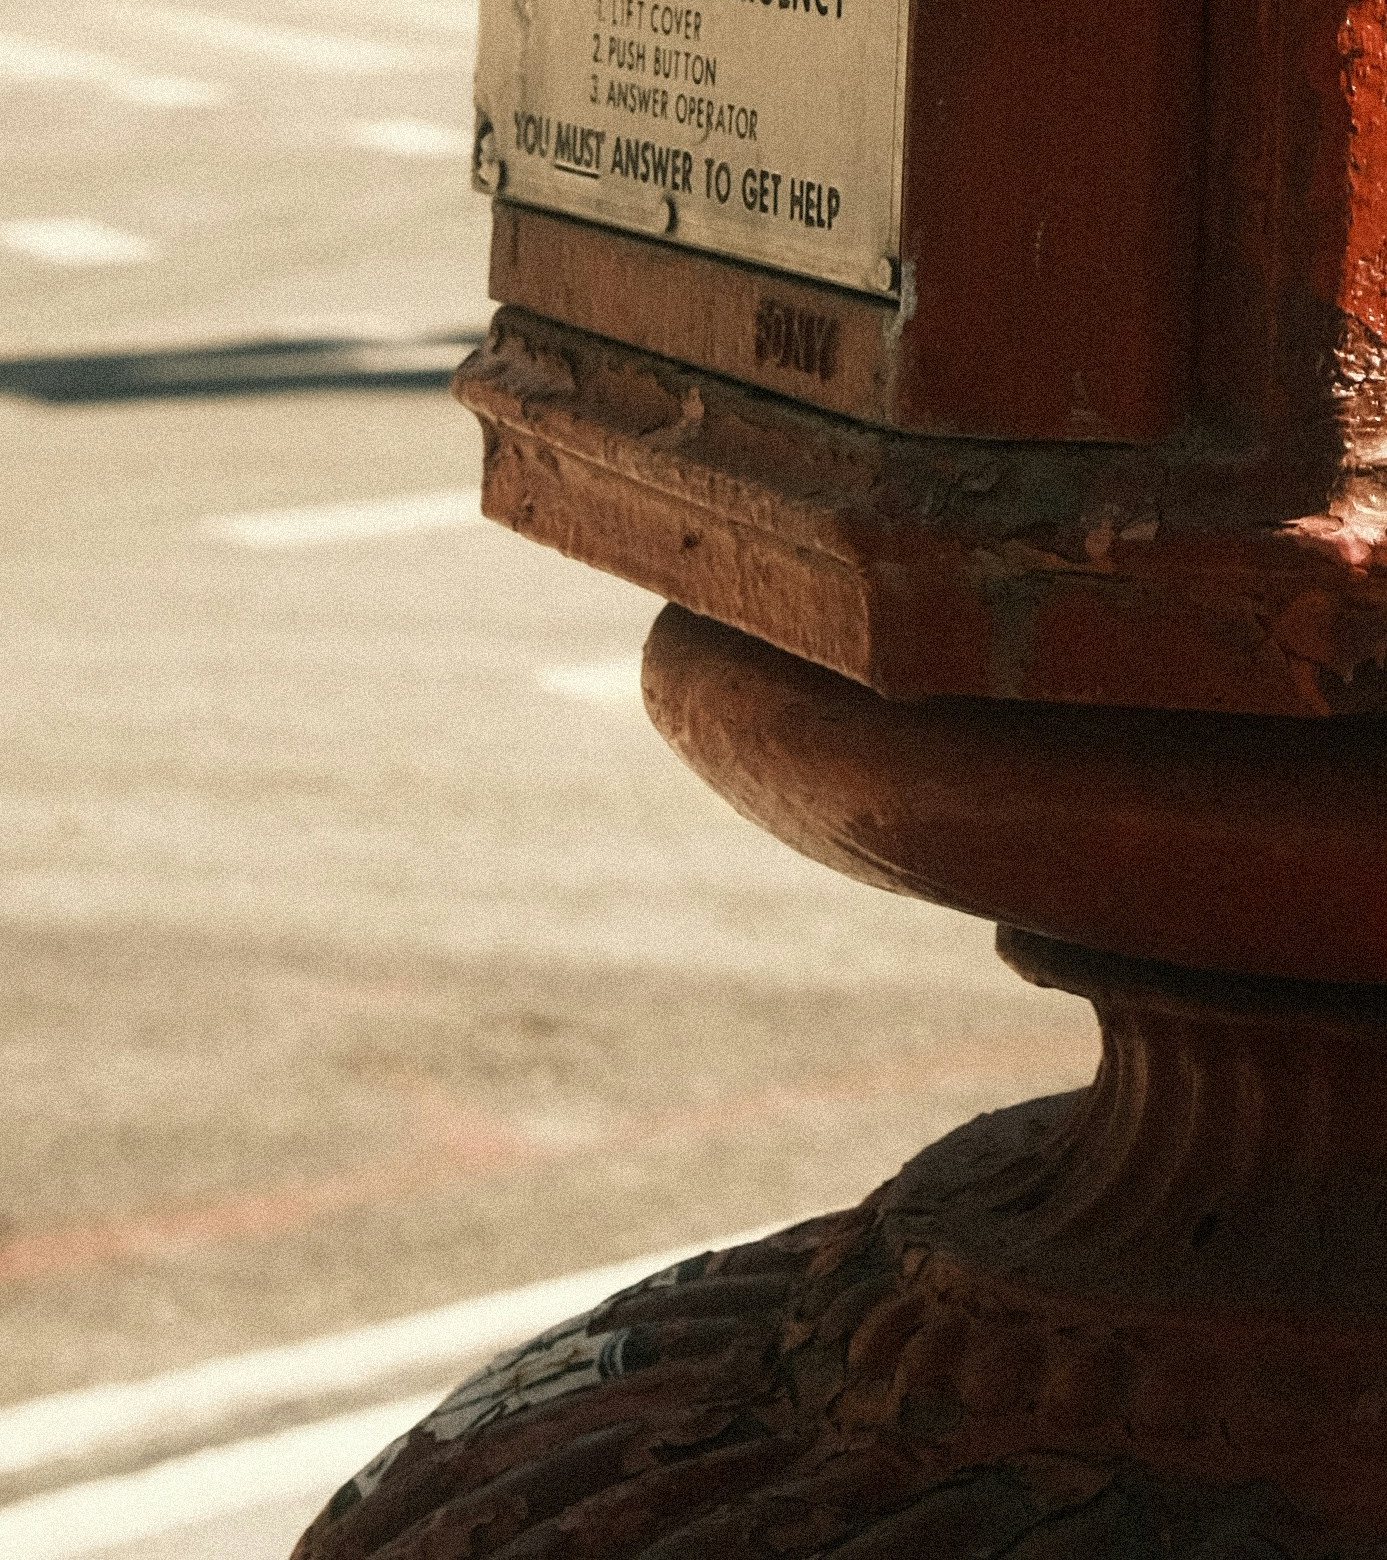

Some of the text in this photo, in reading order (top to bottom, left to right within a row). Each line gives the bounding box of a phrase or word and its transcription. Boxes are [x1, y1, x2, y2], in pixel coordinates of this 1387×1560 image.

[650, 4, 701, 40] COVER
[608, 36, 646, 72] PUSH
[653, 46, 717, 87] BUTTON
[606, 81, 669, 119] ANSWER
[675, 93, 758, 141] OPERATOR
[514, 110, 841, 231] YOU MUST ANSWER TO GET HELP
